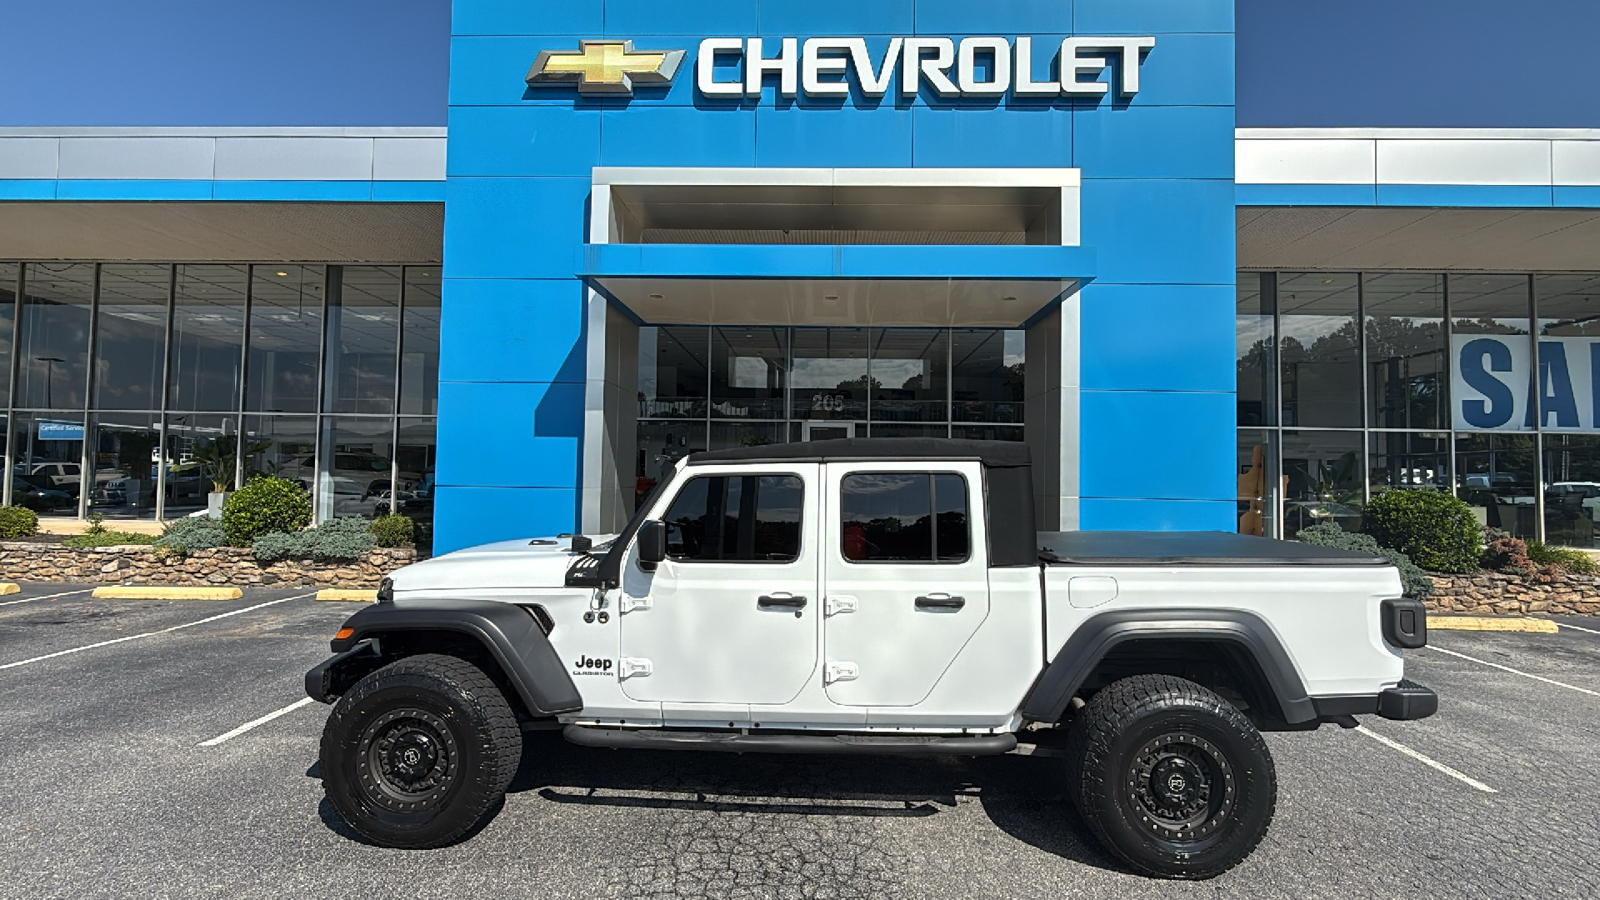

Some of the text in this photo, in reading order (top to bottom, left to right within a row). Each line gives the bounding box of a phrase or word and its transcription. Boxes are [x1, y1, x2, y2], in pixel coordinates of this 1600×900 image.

[698, 37, 1156, 98] CHEVROLET
[811, 394, 845, 411] 205
[1459, 338, 1600, 429] SA
[575, 654, 612, 671] Jeep
